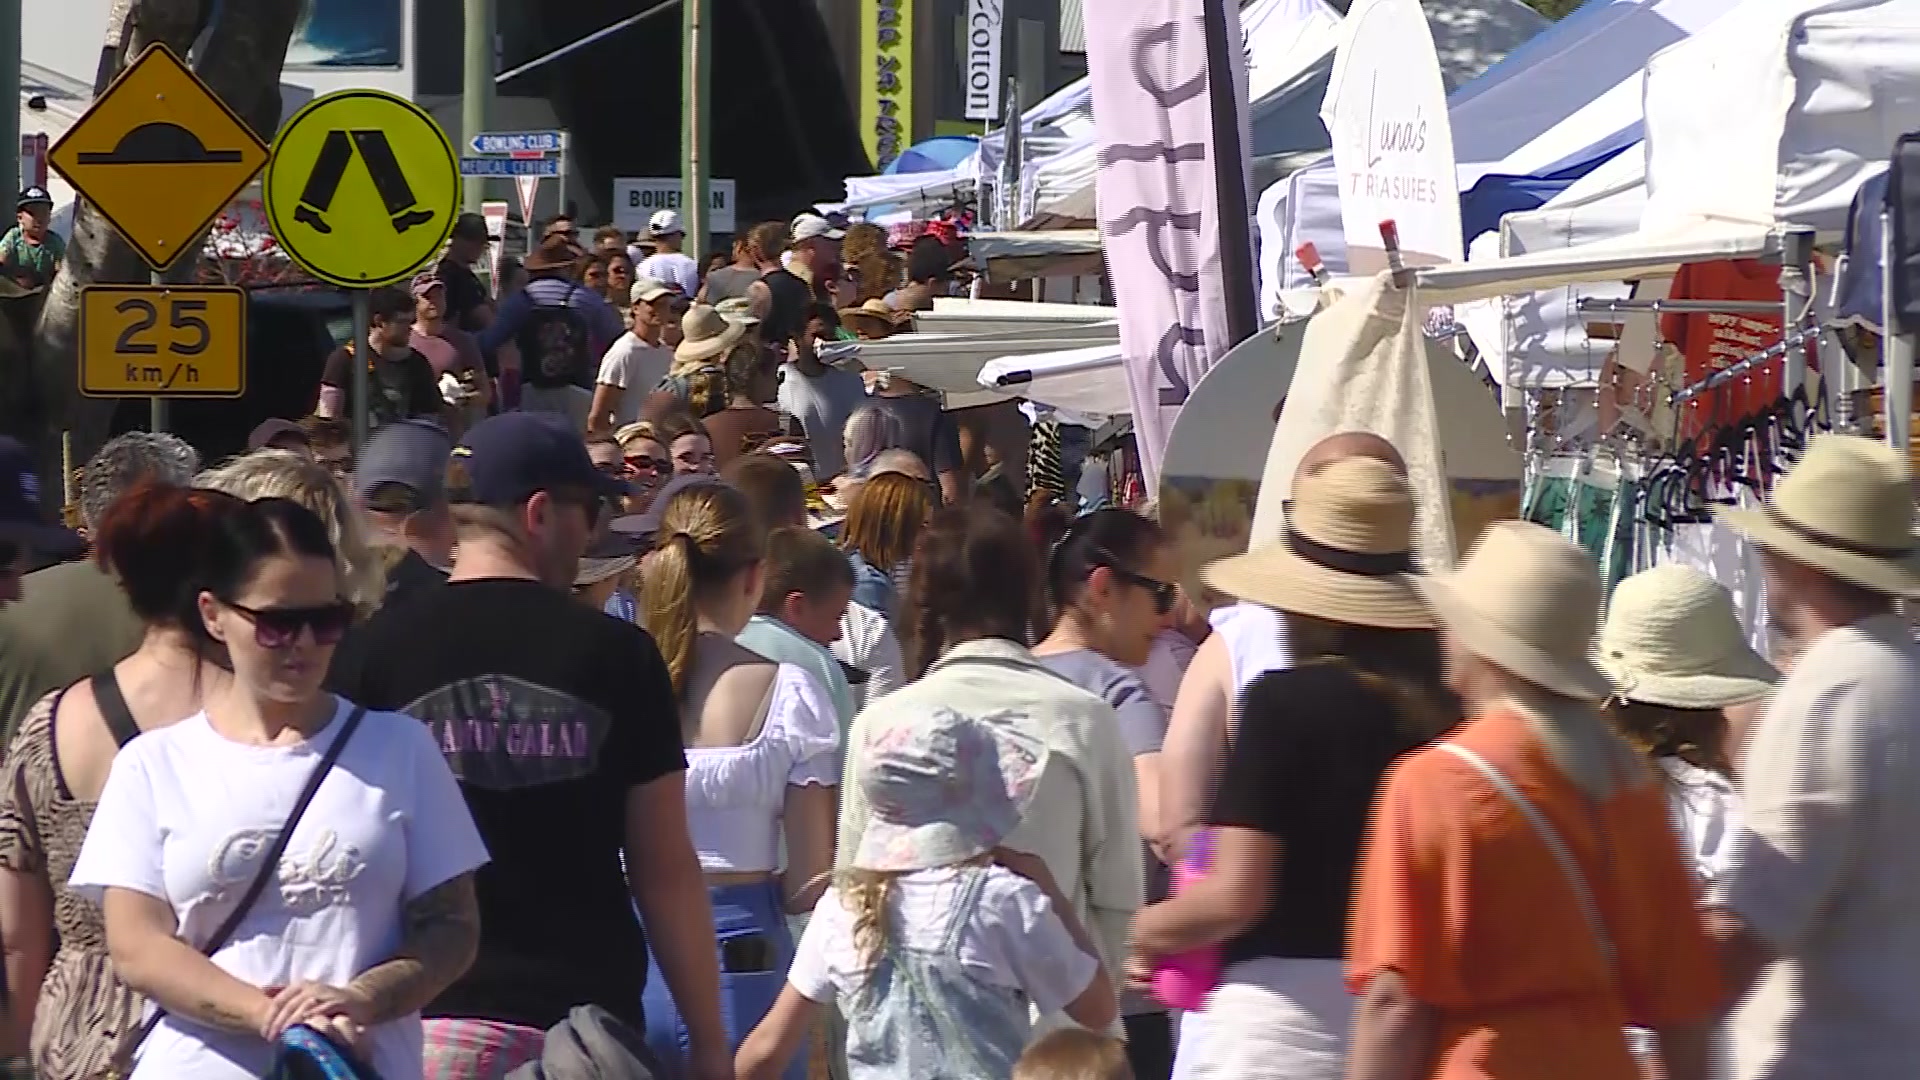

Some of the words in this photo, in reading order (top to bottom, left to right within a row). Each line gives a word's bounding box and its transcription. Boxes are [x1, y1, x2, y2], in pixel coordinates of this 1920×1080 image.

[971, 12, 991, 110] cotton
[1368, 68, 1427, 169] Luna's
[482, 136, 526, 151] BOWLING
[527, 134, 554, 149] CLUB
[461, 159, 509, 175] MEDICAL
[512, 159, 554, 175] CENTRE
[629, 190, 725, 209] BOHEN
[115, 298, 211, 355] 25
[126, 363, 200, 389] km/h
